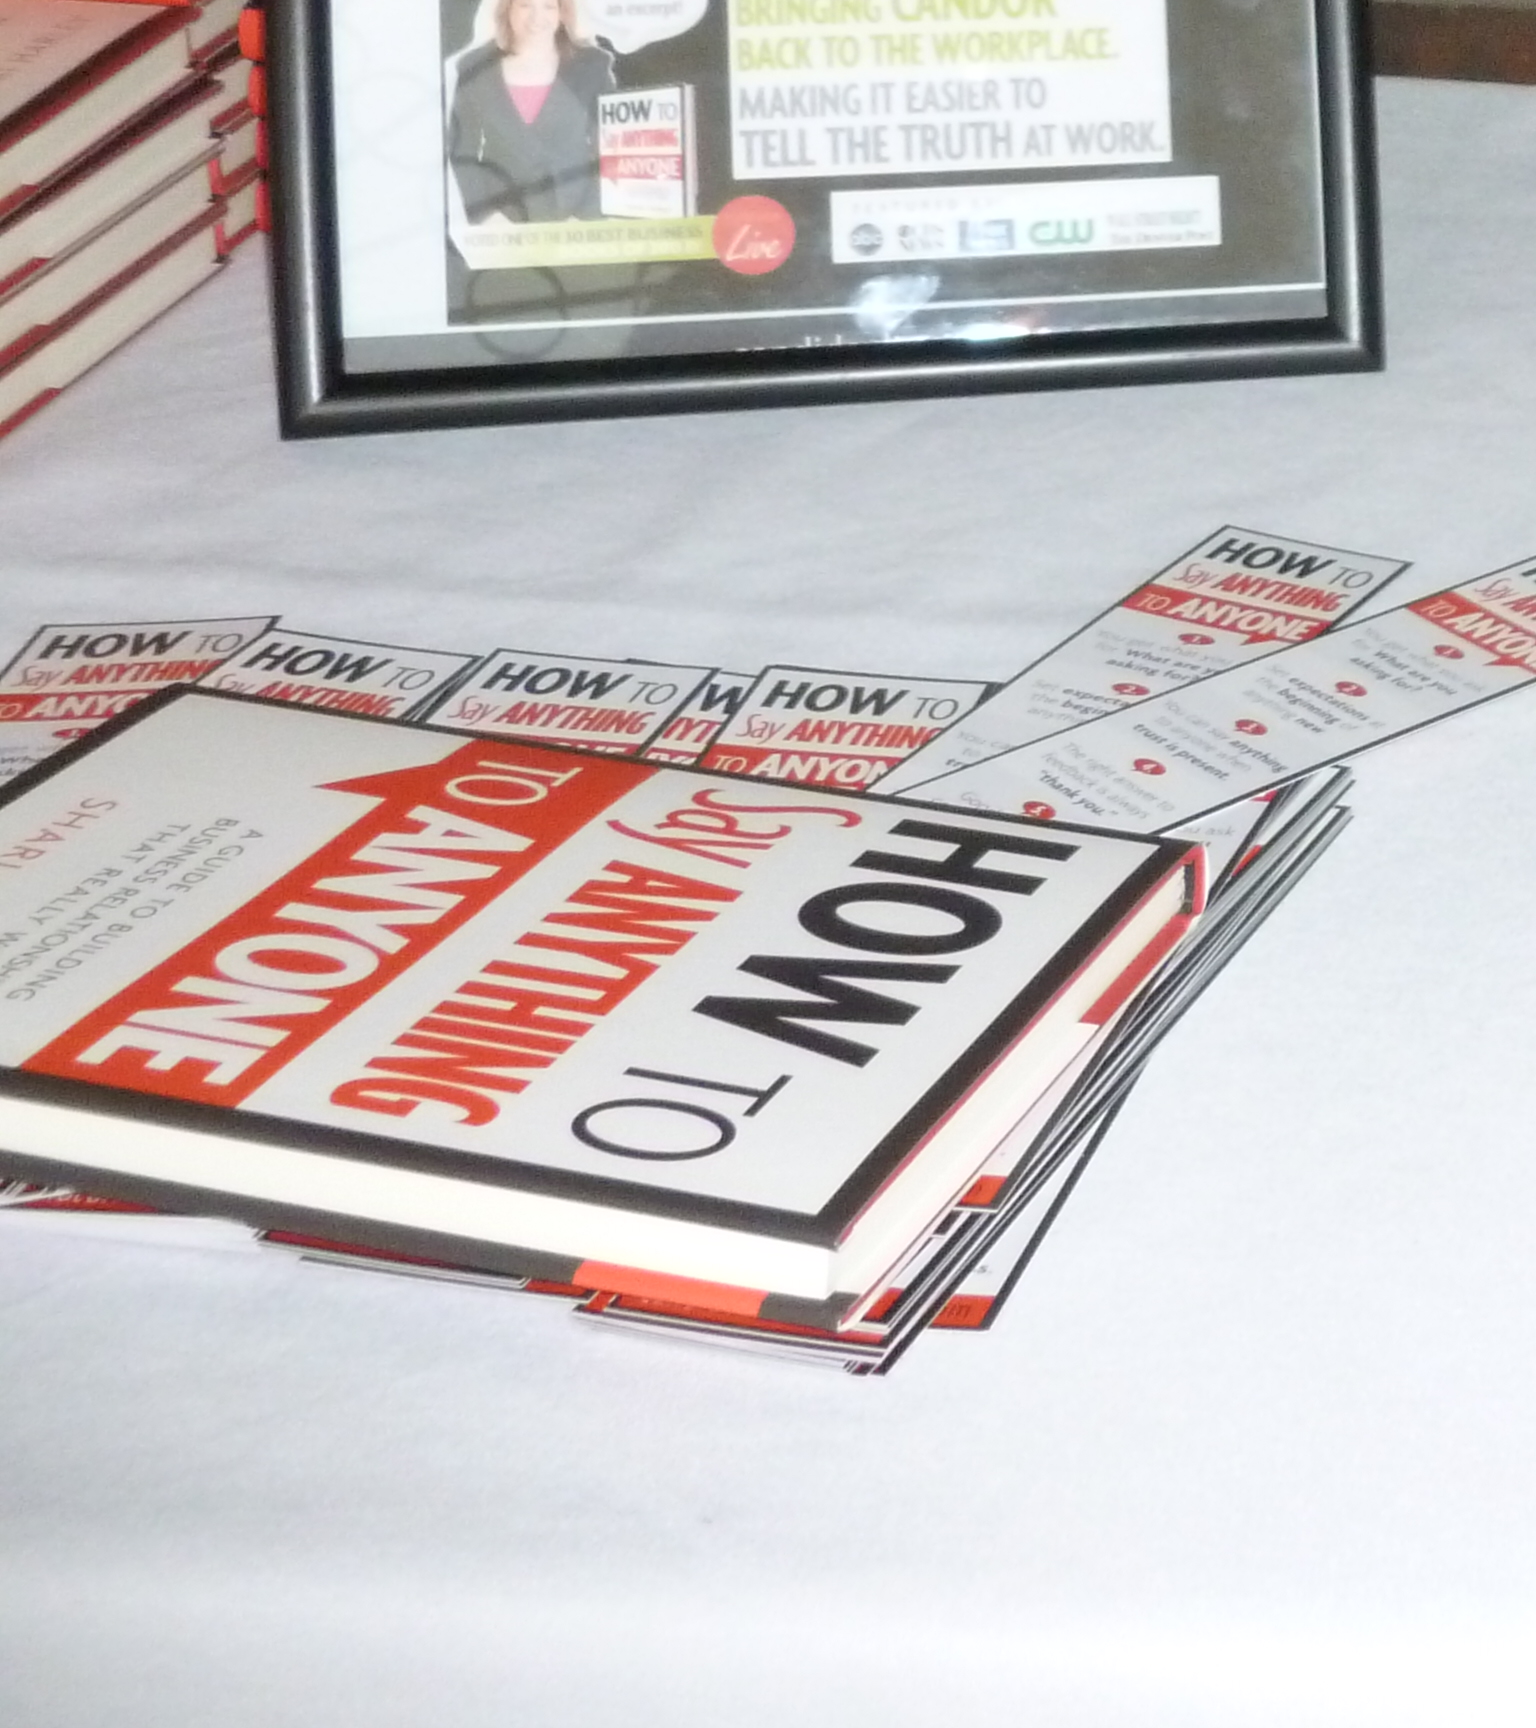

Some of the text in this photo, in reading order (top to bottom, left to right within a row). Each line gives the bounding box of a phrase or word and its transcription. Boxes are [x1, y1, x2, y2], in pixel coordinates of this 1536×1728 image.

[736, 28, 1120, 72] BACK TO THE WORKPLACE.
[601, 99, 679, 124] HOW TO
[738, 78, 1047, 120] MAKING IT EASIER TO
[739, 121, 1165, 168] TELL THE TRUTH AT WORK.
[725, 224, 782, 262] Live
[1204, 537, 1375, 589] HOW TO
[1172, 562, 1351, 613] Say ANYTHING
[1428, 598, 1458, 619] TO
[1473, 577, 1516, 604] Say
[1136, 593, 1321, 642] TO ANYONE
[36, 630, 244, 660] HOW TO
[242, 642, 435, 691] HOW TO
[12, 665, 62, 692] Say
[481, 662, 679, 705] HOW TO
[761, 679, 911, 716] HOW
[911, 696, 959, 720] TO
[1288, 676, 1370, 722] expectations
[446, 695, 501, 728] Say
[500, 700, 656, 736] ANYTHING
[735, 713, 785, 744] Say
[1276, 689, 1341, 726] beginning
[714, 754, 747, 773] TO
[1228, 739, 1289, 774] anything
[132, 817, 240, 885] BUSINESS
[28, 823, 192, 926] THAT REALLY
[5, 844, 245, 1002] GUIDE TO BUILDING
[75, 759, 584, 1088] TO ANYONE
[328, 787, 863, 1128] Say ANYTHING
[571, 818, 1083, 1162] HOW TO
